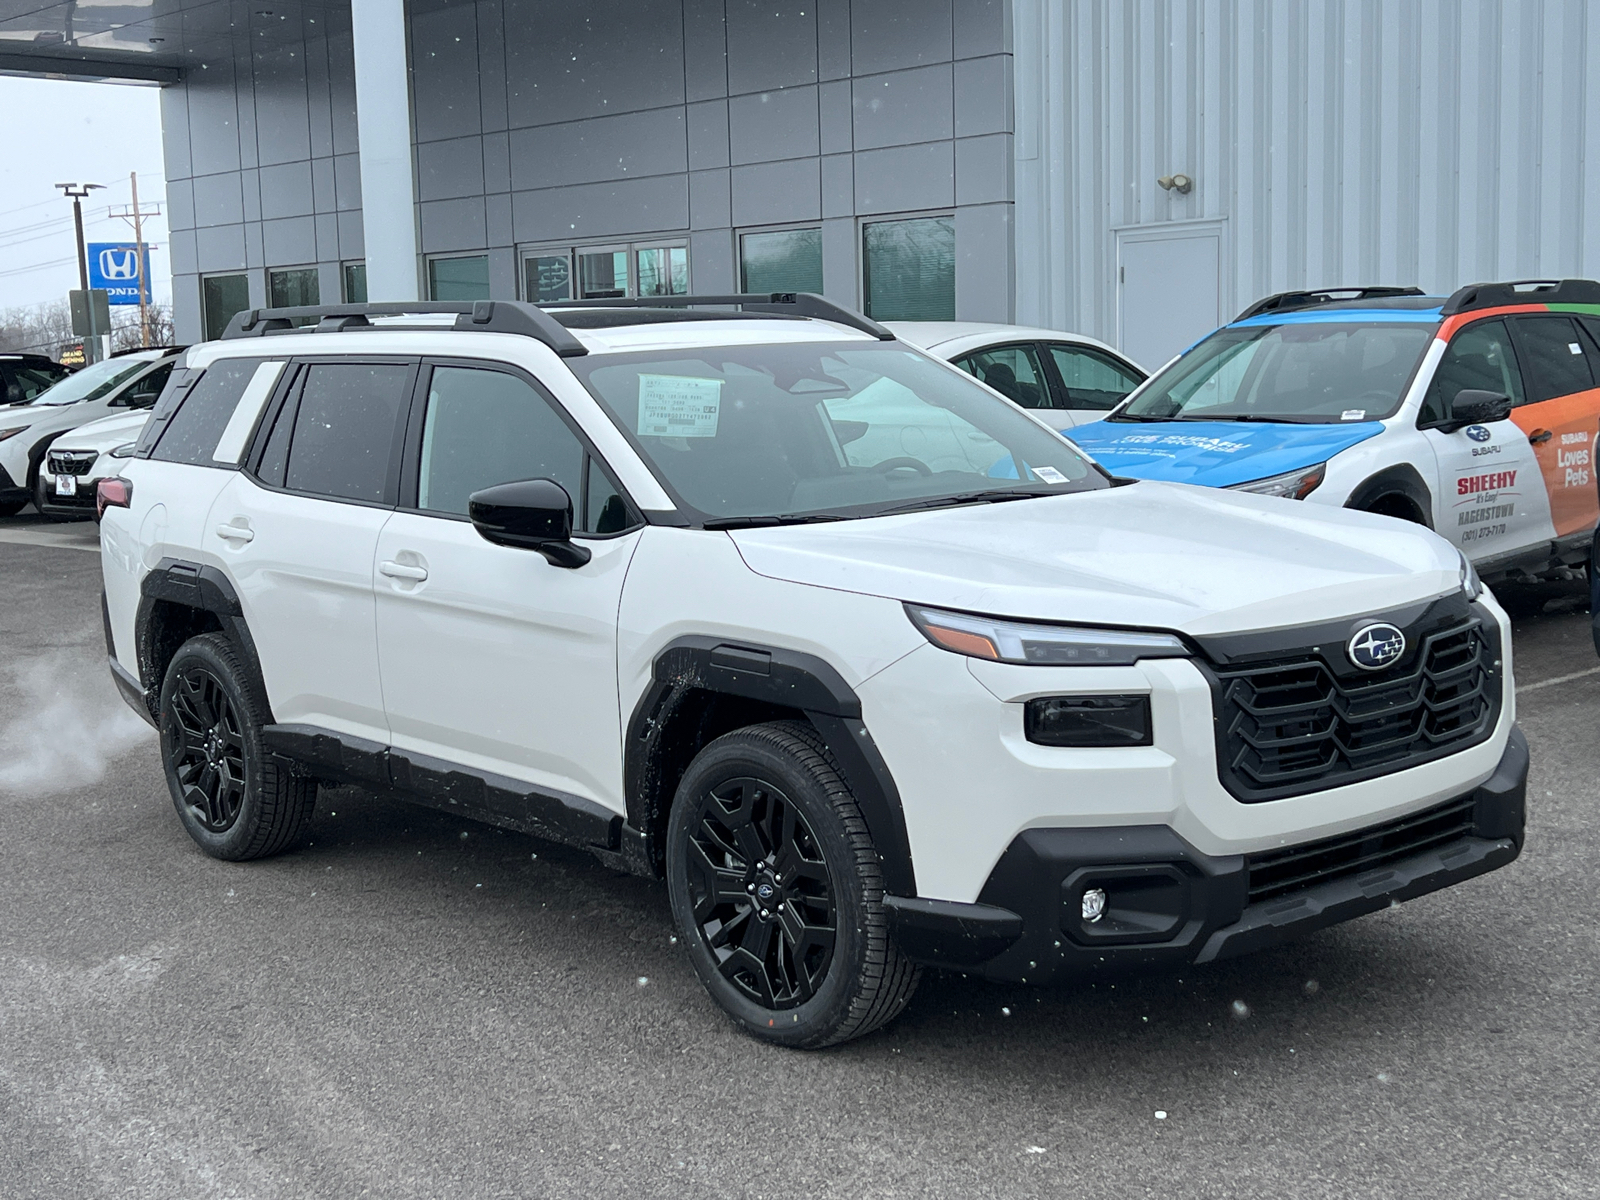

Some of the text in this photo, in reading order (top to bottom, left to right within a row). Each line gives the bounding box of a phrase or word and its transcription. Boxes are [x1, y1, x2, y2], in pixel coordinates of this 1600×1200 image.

[92, 287, 149, 296] OND
[1561, 431, 1588, 445] SUBARU
[1472, 445, 1501, 456] SUBARU
[1558, 448, 1589, 468] Loves
[1457, 470, 1517, 495] SHEEHY
[1565, 467, 1589, 488] Pets
[1458, 503, 1515, 526] HAGERSTOWN
[1461, 528, 1478, 543] (301)
